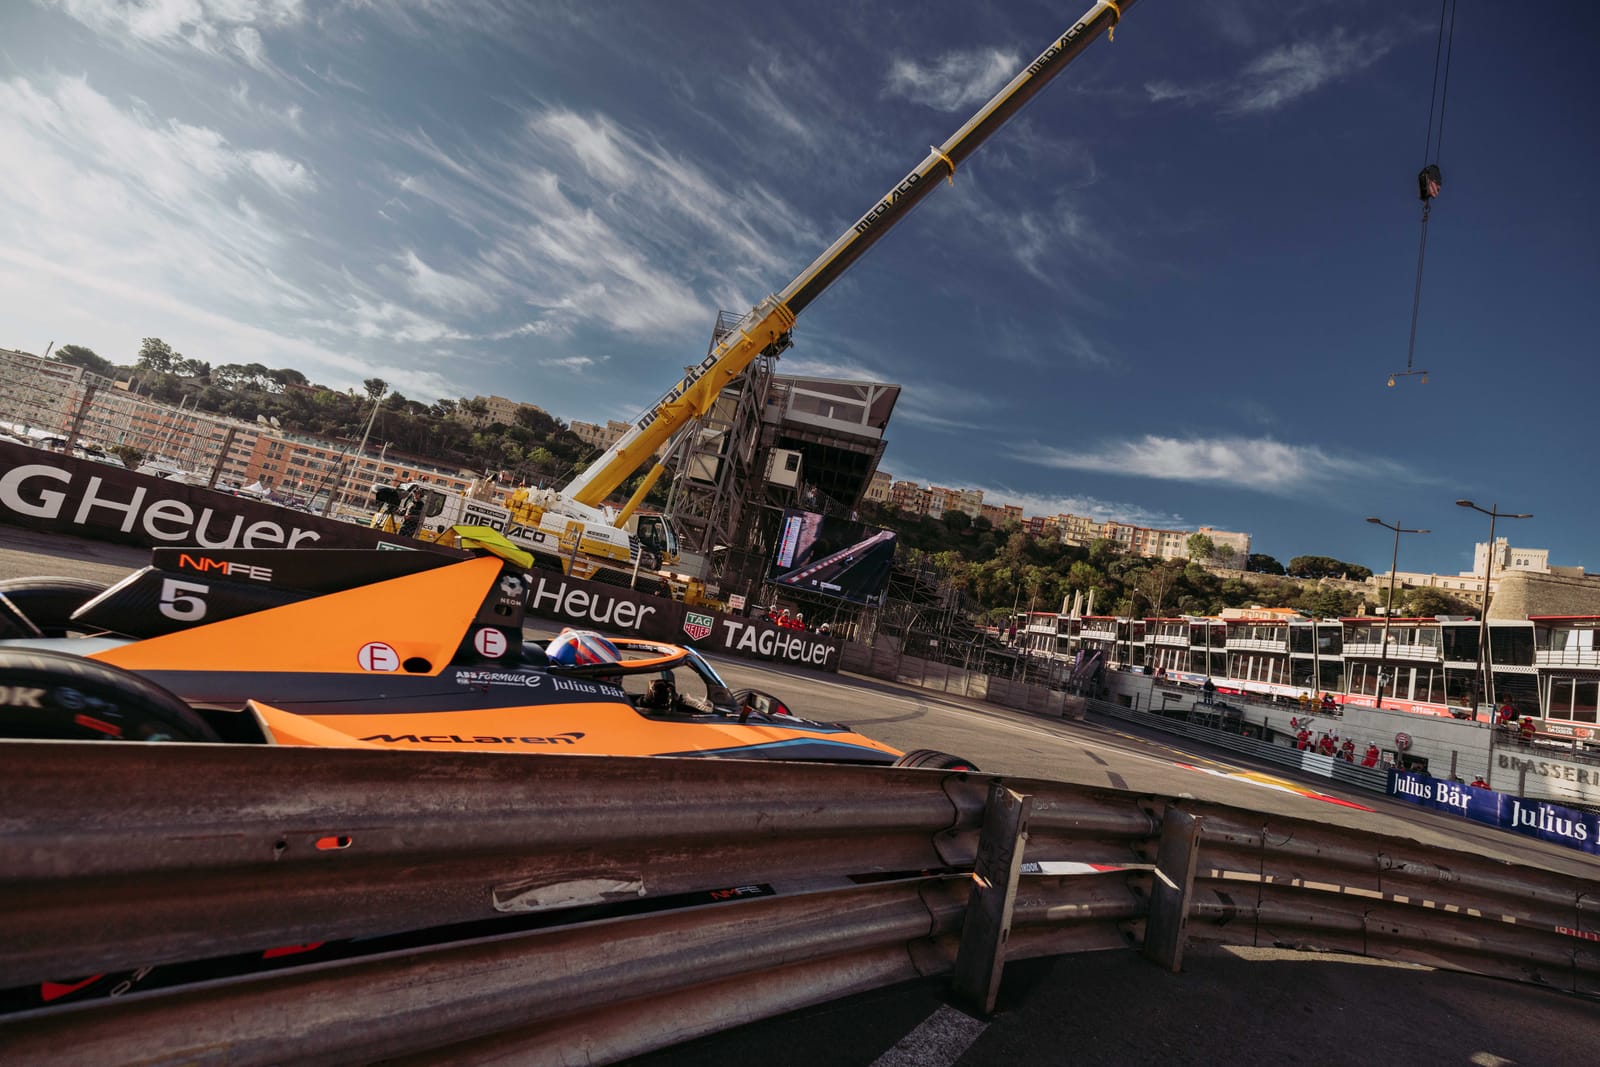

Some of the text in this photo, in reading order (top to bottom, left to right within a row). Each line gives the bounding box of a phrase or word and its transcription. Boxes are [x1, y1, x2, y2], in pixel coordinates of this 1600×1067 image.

[159, 578, 210, 622] 5
[525, 573, 656, 630] Heuer
[688, 614, 712, 627] TAG
[552, 678, 625, 699] Julius Bär
[1393, 769, 1472, 811] Julius Bär
[1511, 800, 1588, 842] Julius
